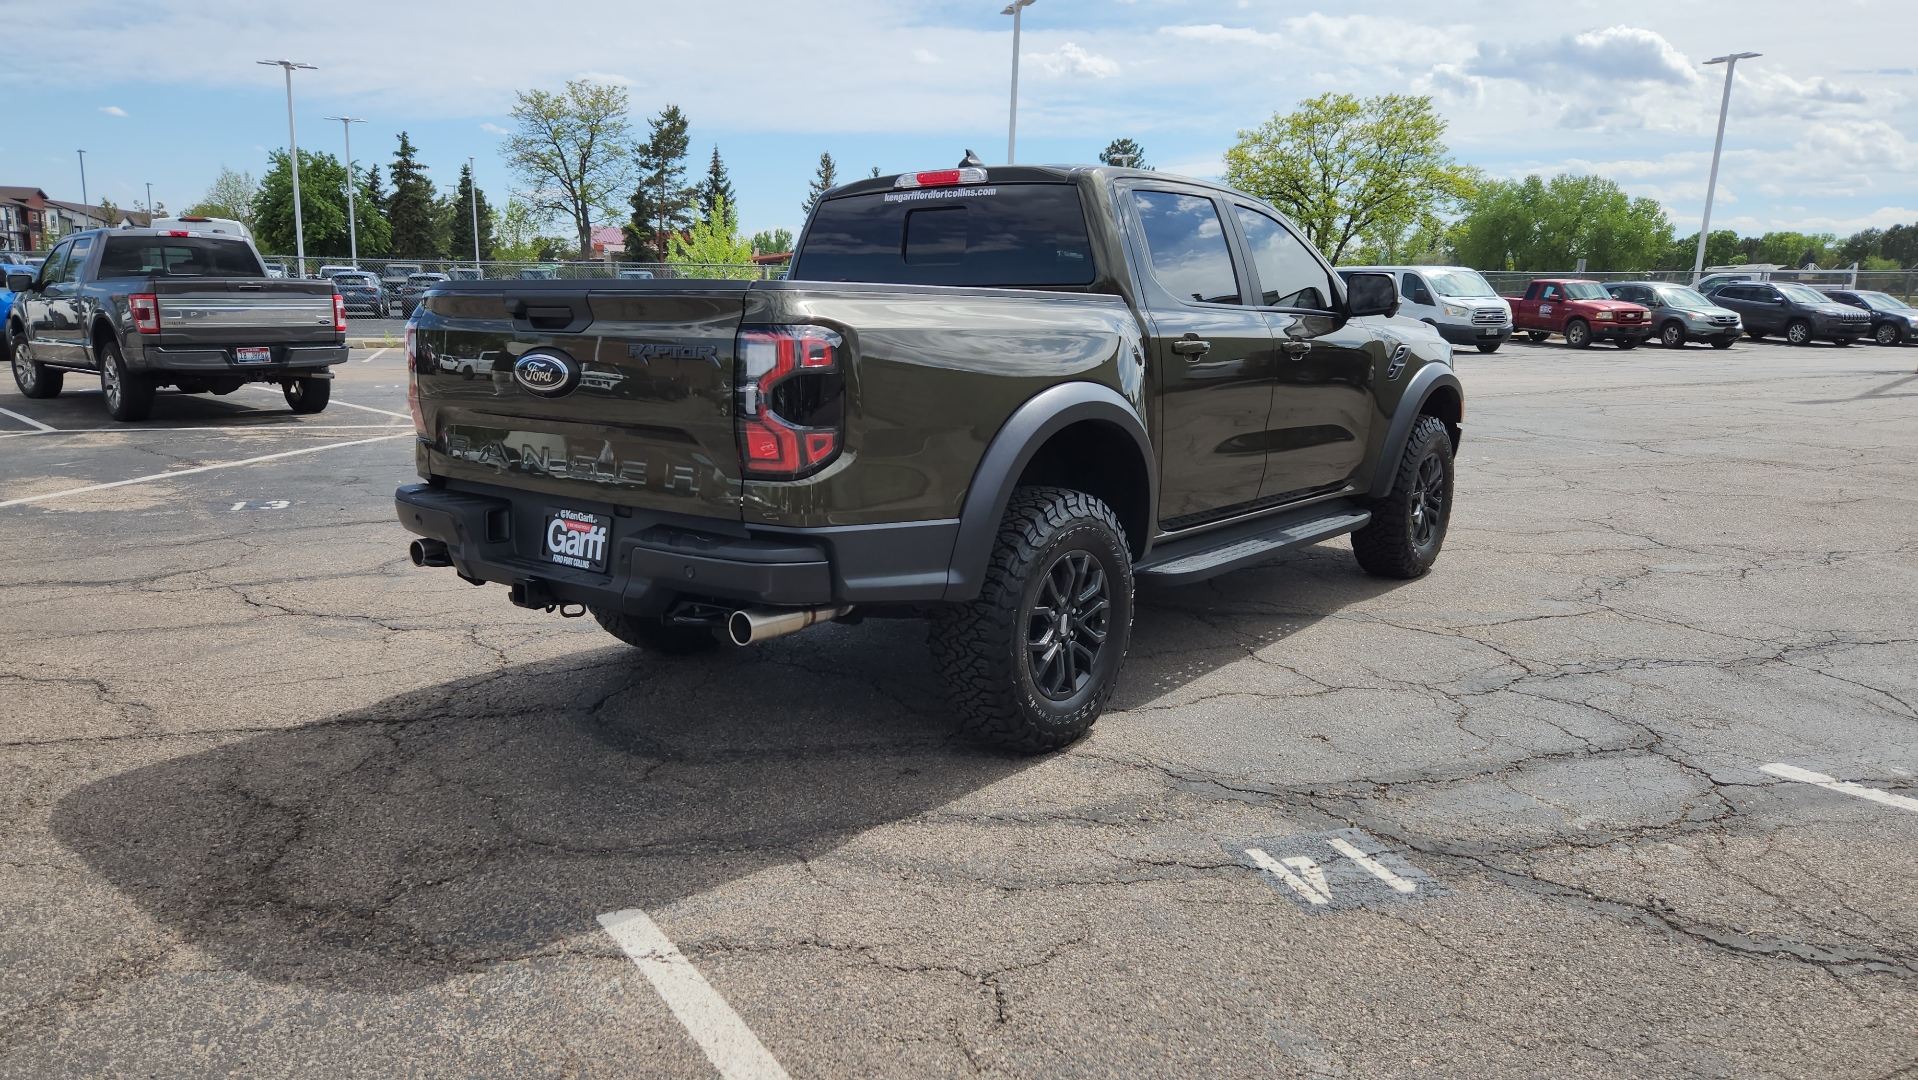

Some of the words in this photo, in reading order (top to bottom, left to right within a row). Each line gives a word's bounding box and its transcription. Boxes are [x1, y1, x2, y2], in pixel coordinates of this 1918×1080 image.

[525, 361, 552, 383] Ford
[627, 343, 722, 369] RAPTOR
[449, 436, 701, 491] RANGER
[547, 519, 607, 560] Garff
